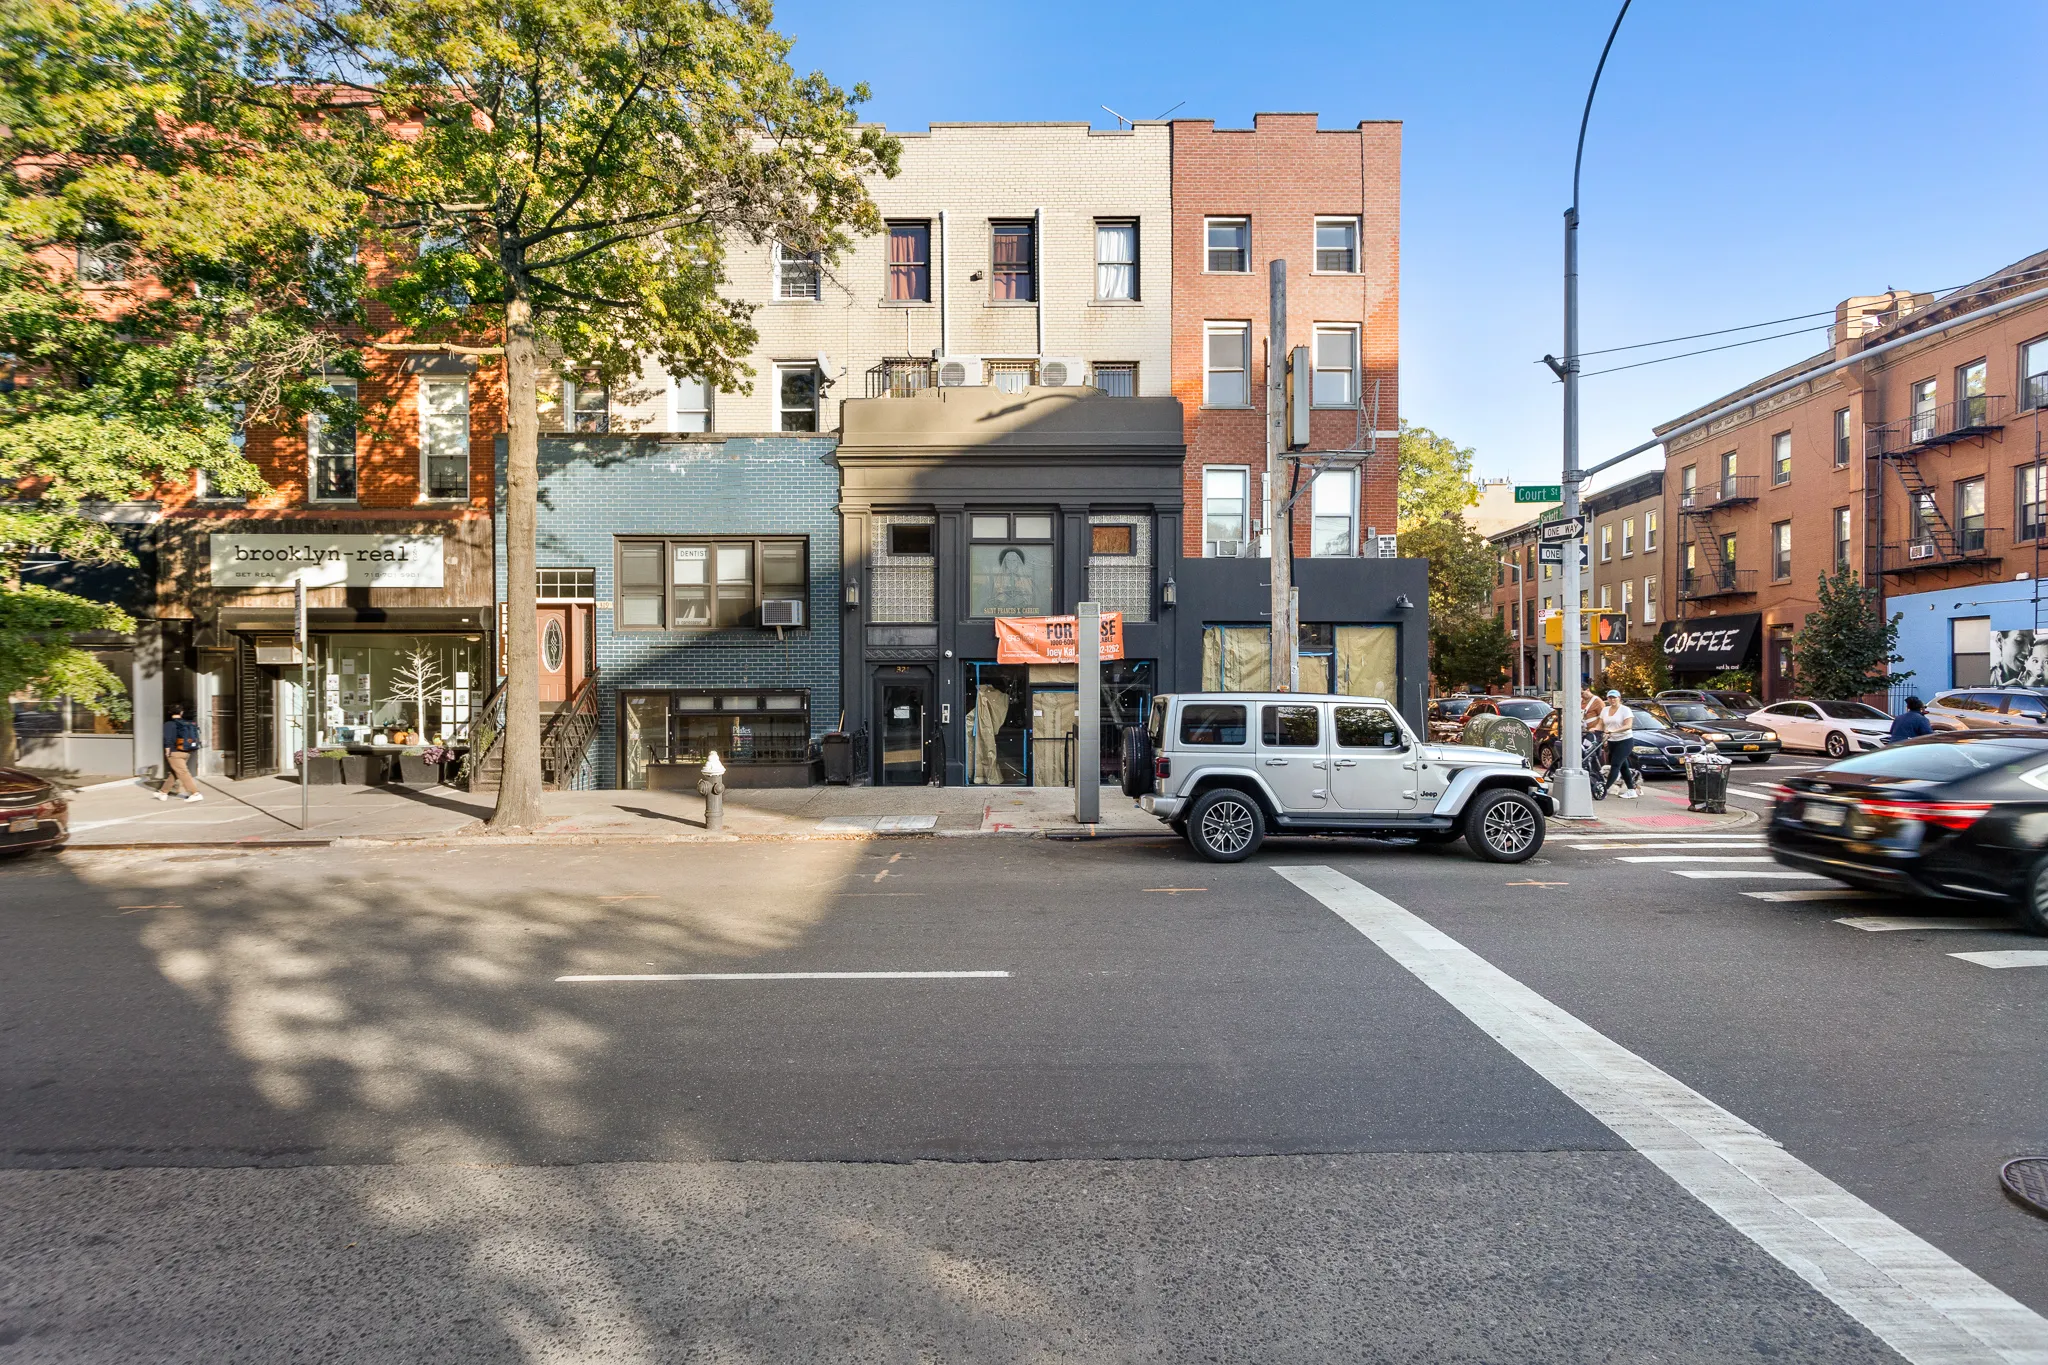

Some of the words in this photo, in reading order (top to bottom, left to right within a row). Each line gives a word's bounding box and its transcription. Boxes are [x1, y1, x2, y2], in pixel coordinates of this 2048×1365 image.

[1518, 488, 1547, 500] Court
[1550, 487, 1558, 496] St
[1547, 527, 1560, 537] ONE
[1564, 524, 1579, 534] WAY
[235, 545, 409, 566] brooklyn-real
[1545, 549, 1561, 559] ONE
[1046, 622, 1073, 640] FOR
[1100, 619, 1117, 636] SE
[1663, 628, 1741, 654] COFFEE
[1046, 647, 1063, 659] Joey
[1100, 644, 1120, 654] 2-1262
[1420, 790, 1438, 798] Jeep
